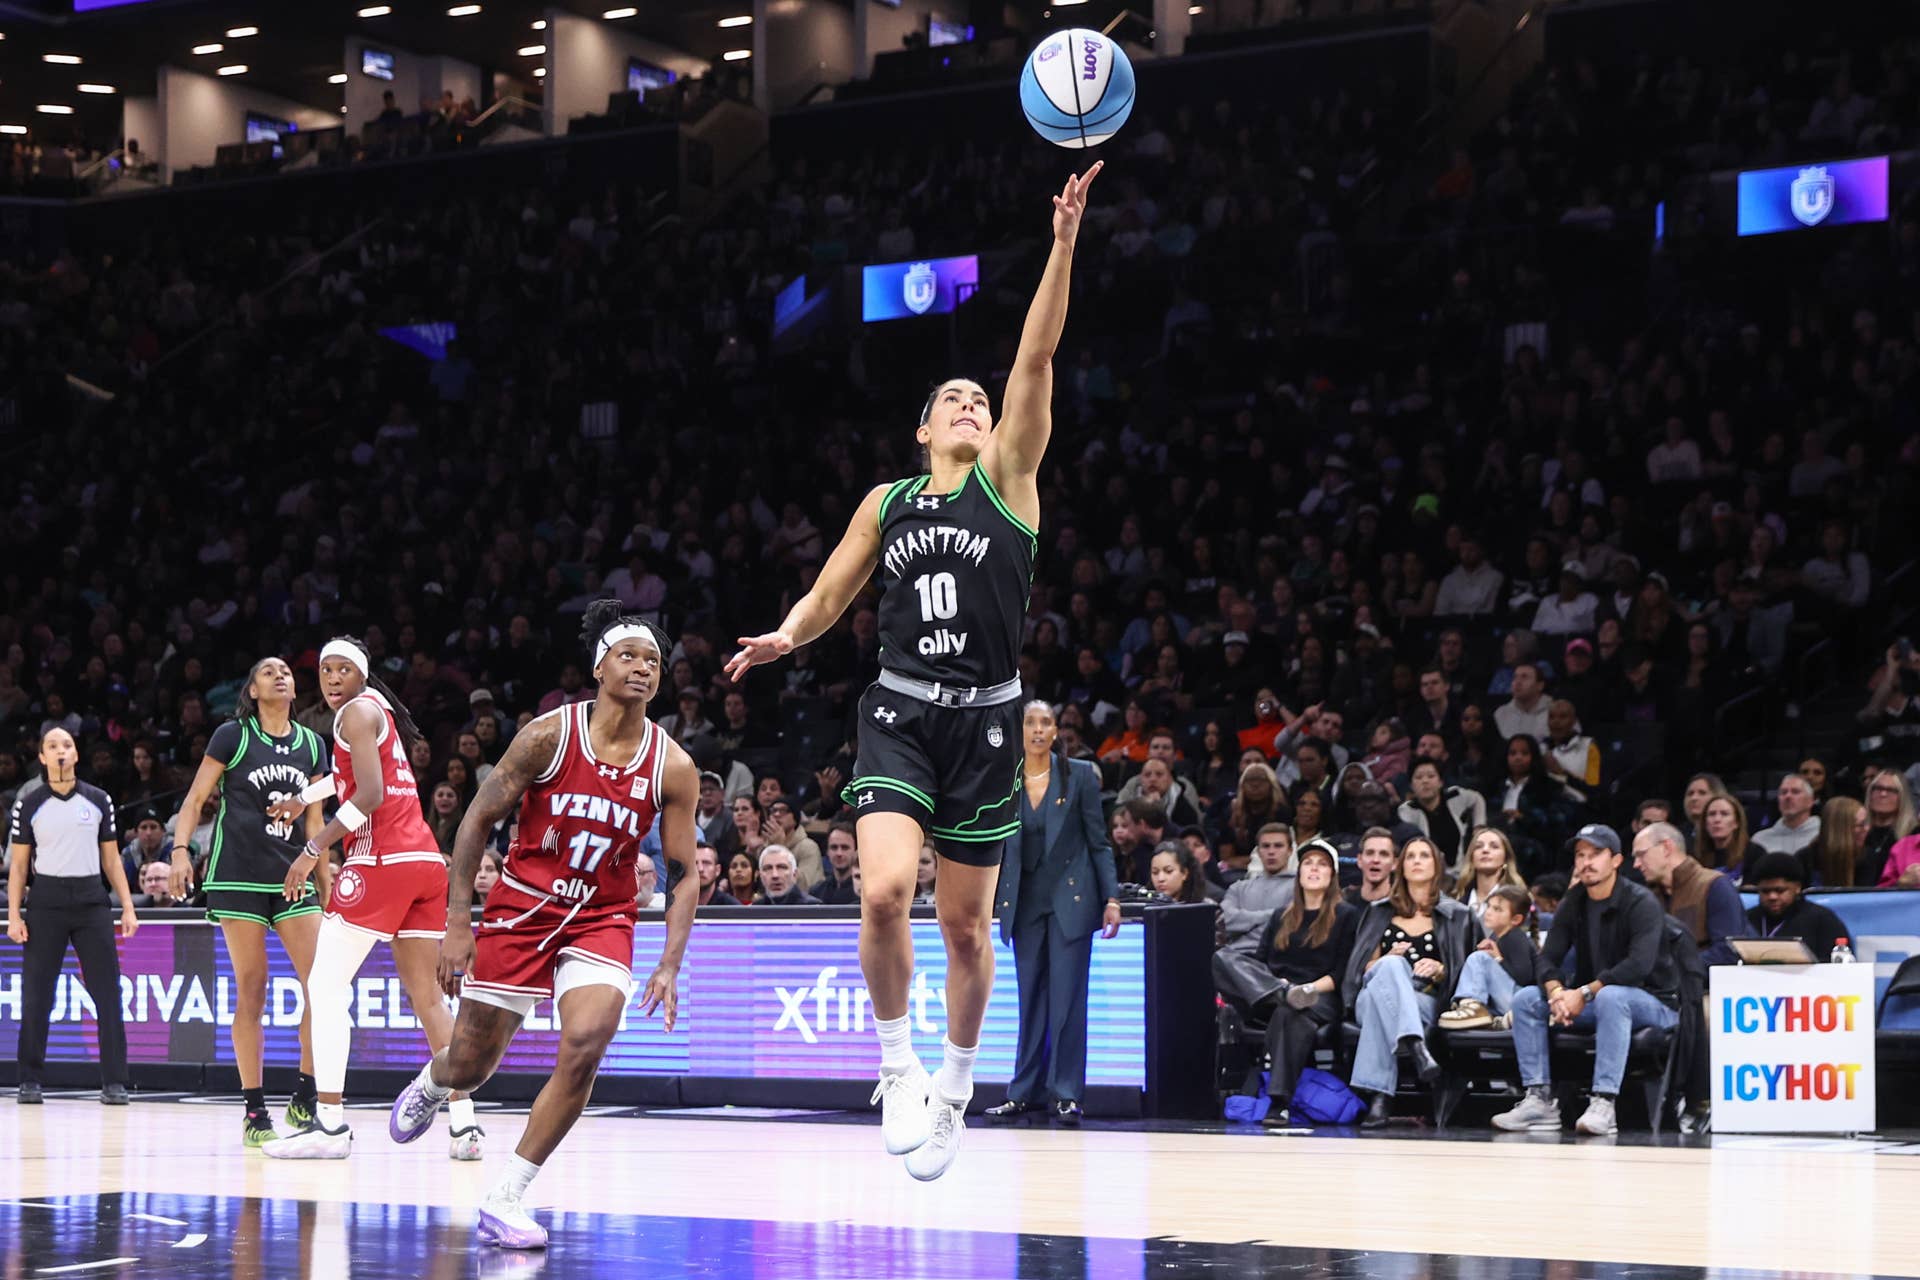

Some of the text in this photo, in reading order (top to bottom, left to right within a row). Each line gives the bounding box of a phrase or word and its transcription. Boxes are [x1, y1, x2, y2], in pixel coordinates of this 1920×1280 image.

[884, 525, 991, 580] PHANTOM
[914, 571, 958, 623] 10
[918, 628, 968, 656] ally
[265, 820, 293, 842] ally
[550, 793, 640, 839] VINYL
[568, 829, 613, 873] 17
[552, 877, 598, 905] ally
